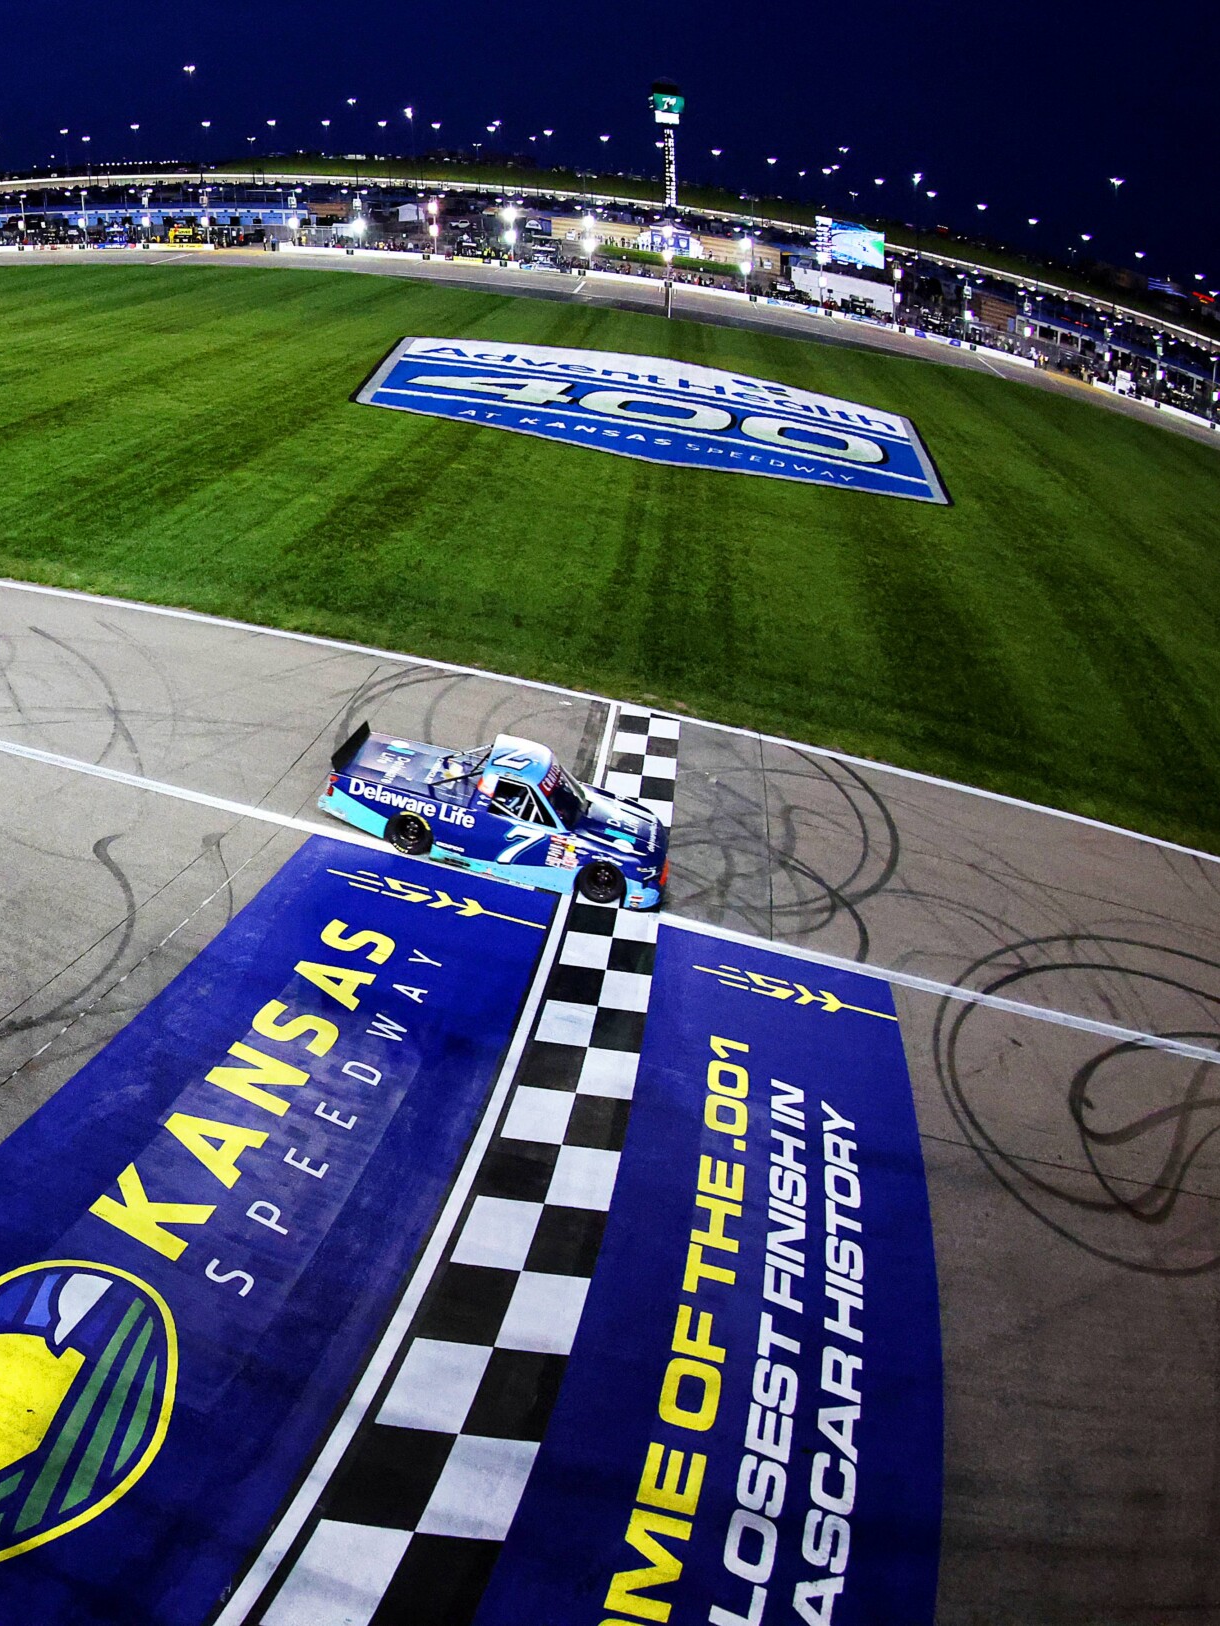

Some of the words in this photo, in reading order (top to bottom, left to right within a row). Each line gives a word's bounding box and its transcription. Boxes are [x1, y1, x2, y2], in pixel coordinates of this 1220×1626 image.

[407, 375, 888, 464] 400
[423, 346, 895, 432] AdventHealth
[459, 409, 502, 419] AT
[519, 416, 672, 446] KANSAS
[685, 442, 855, 483] SPEEDWAY
[348, 778, 436, 818] Delaware
[439, 804, 476, 829] Life
[496, 824, 548, 865] 7
[88, 918, 396, 1261] KANSAS
[205, 949, 442, 1297] SPEEDWAY
[704, 1034, 750, 1152] .001
[770, 1078, 806, 1131] IN
[682, 1154, 746, 1293] THE
[763, 1128, 807, 1314] FINISH
[821, 1099, 864, 1343] HISTORY
[658, 1304, 727, 1432] OF
[597, 1441, 708, 1626] ME
[792, 1346, 863, 1626] ASCAR
